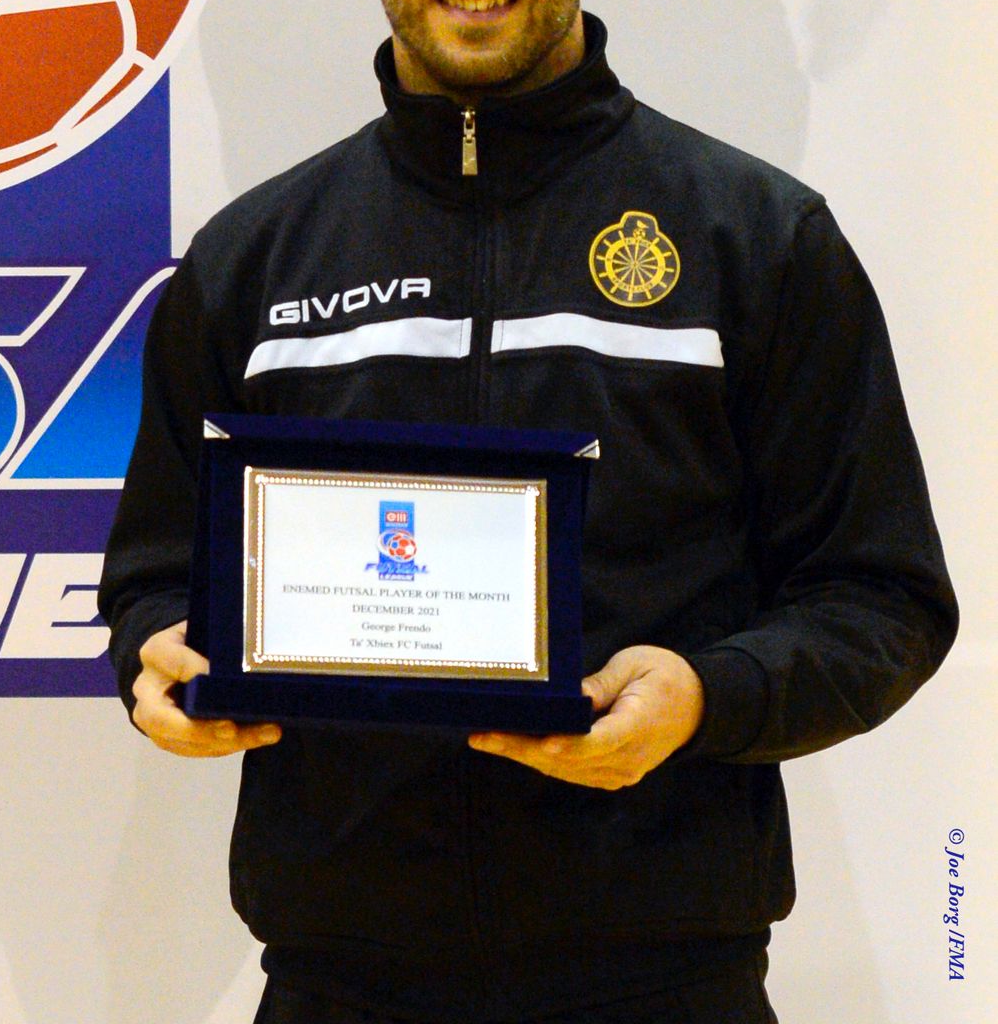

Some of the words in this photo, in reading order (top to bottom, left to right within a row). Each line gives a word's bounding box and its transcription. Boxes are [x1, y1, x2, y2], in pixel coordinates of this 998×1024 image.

[269, 277, 432, 326] GIVOVA
[282, 584, 331, 595] ENEMED
[333, 586, 377, 597] FUTSAL
[379, 588, 423, 599] PLAYER
[425, 590, 440, 600] OF
[442, 591, 465, 601] THE
[468, 592, 510, 602] MONTH
[352, 604, 415, 616] DECEMBER
[417, 607, 440, 617] 2021
[361, 622, 396, 633] George
[398, 623, 432, 633] Frendo
[366, 639, 394, 649] Xbiex
[397, 640, 412, 649] FC
[414, 641, 443, 651] Futsal
